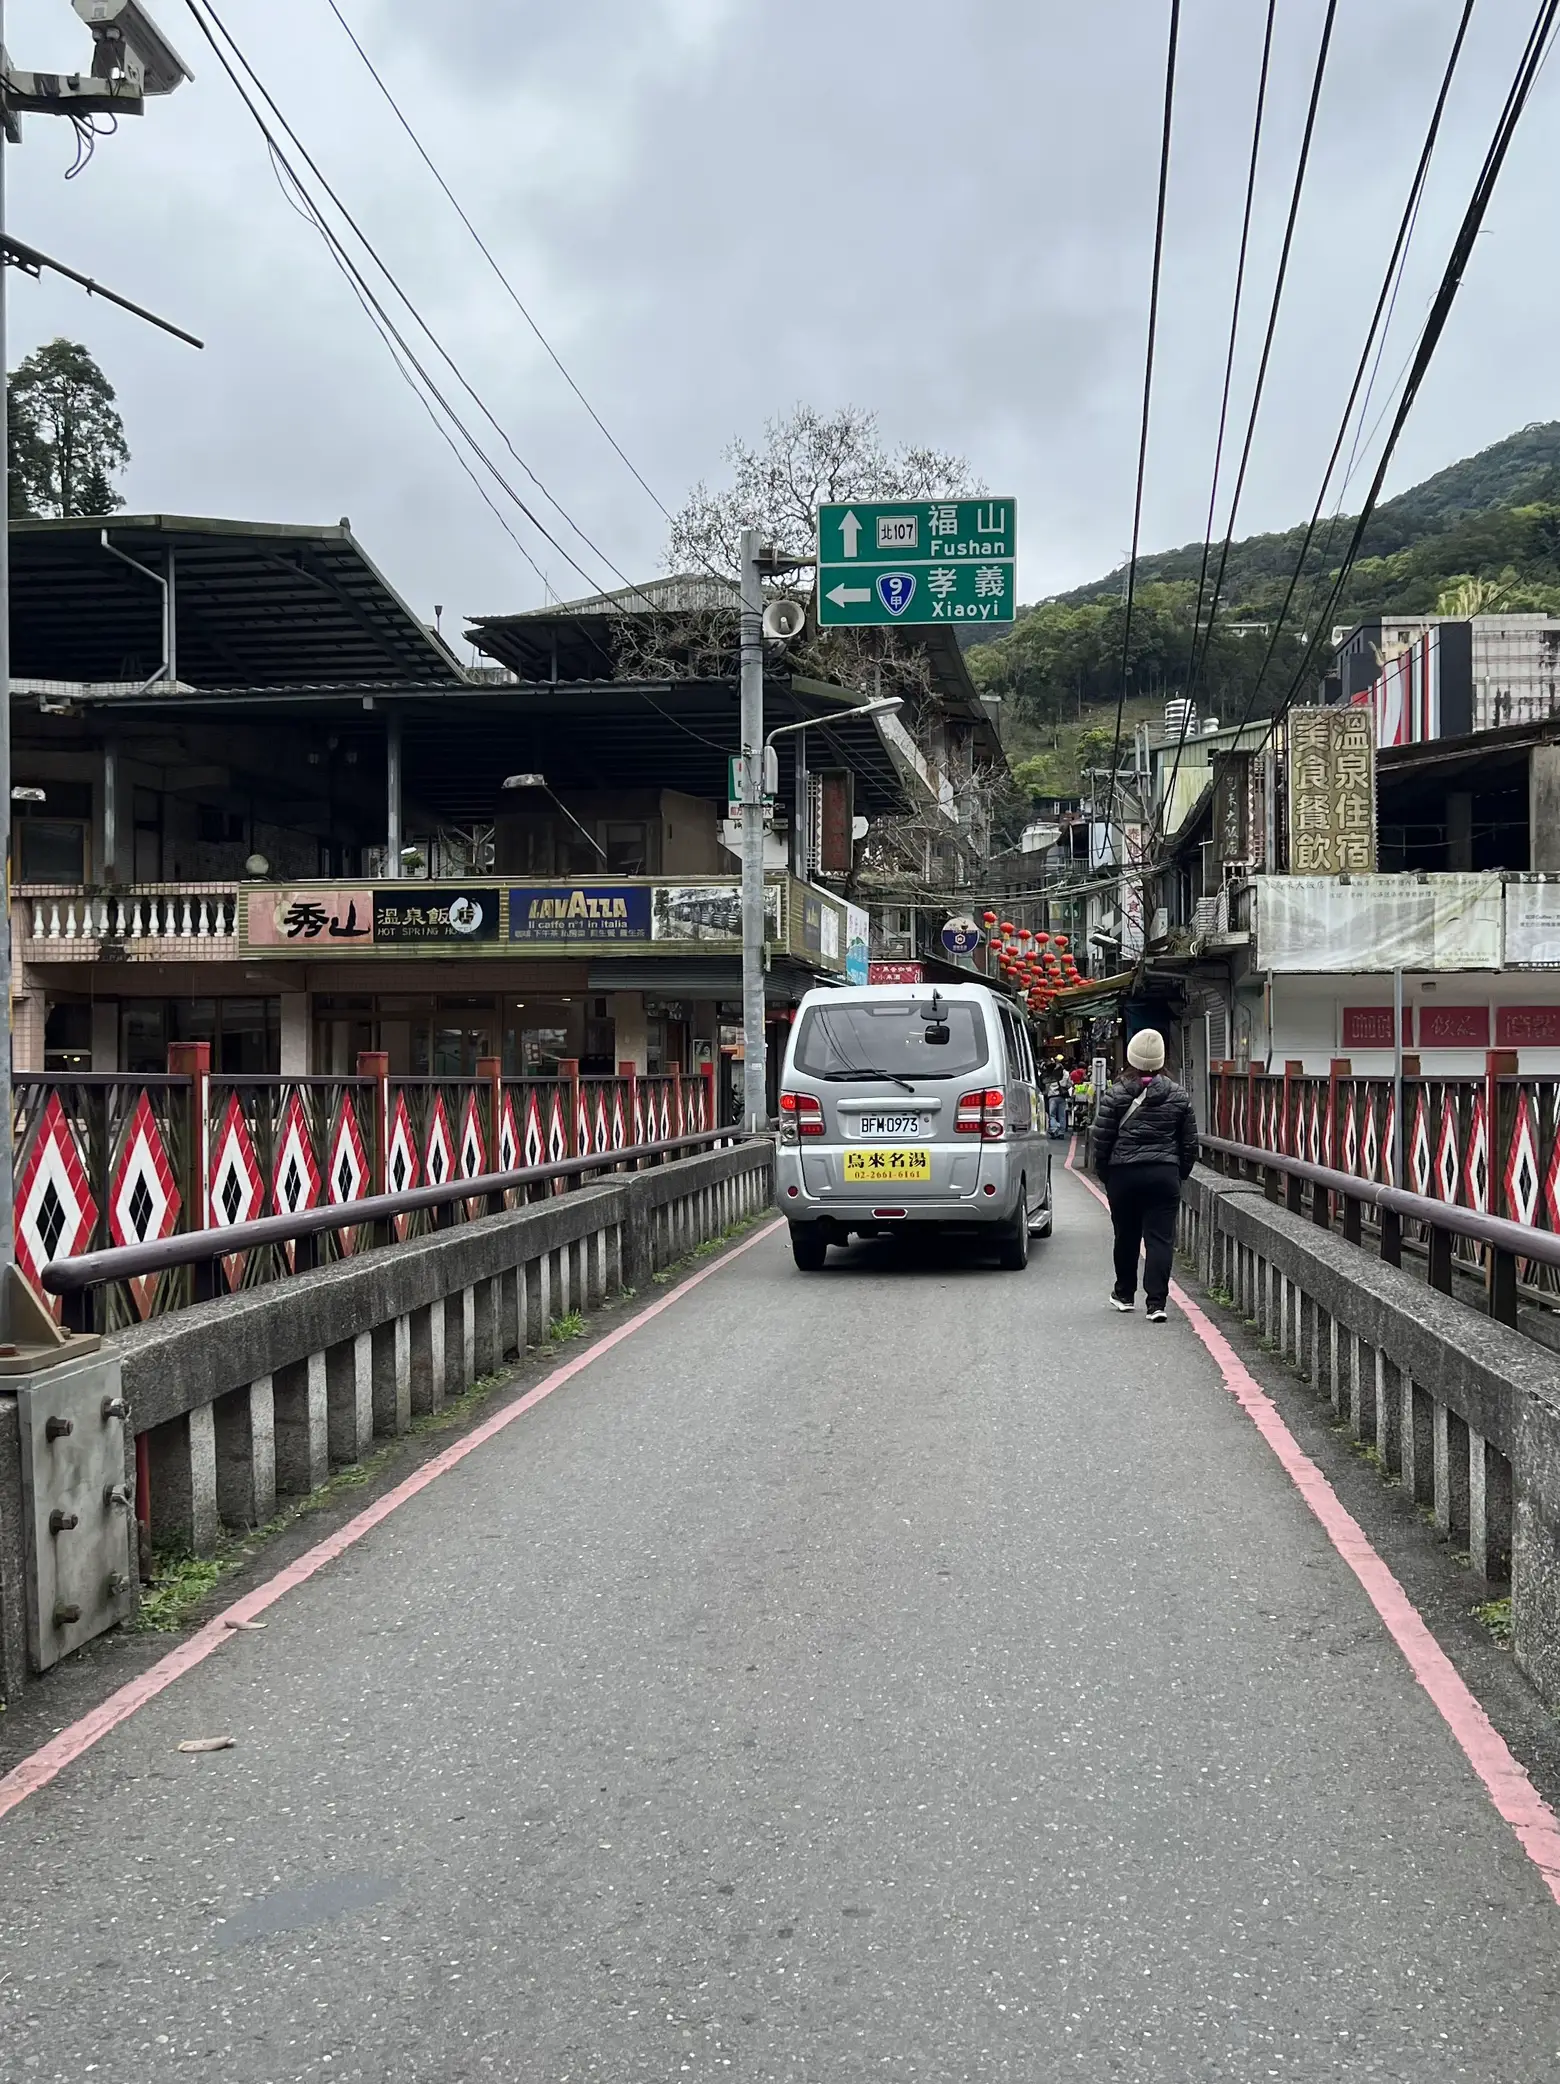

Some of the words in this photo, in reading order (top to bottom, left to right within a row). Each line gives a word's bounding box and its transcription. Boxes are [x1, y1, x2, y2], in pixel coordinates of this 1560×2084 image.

[928, 503, 1005, 536] 福山
[881, 524, 913, 540] 北107
[930, 540, 1005, 556] Fushan
[889, 578, 902, 596] 9
[928, 566, 1005, 598] 孝義
[890, 596, 902, 609] 甲
[931, 600, 999, 620] Xiaoyi
[1295, 714, 1331, 869] 美食餐飲
[1334, 712, 1370, 869] 溫泉住宿
[528, 890, 628, 919] LAVAZZA
[284, 899, 371, 938] 秀山
[377, 907, 475, 926] 溫泉飯店
[377, 927, 396, 936] HOT
[402, 927, 439, 936] SPRING
[847, 1152, 926, 1169] 烏來名湯
[854, 1171, 920, 1179] 02-2661-6161
